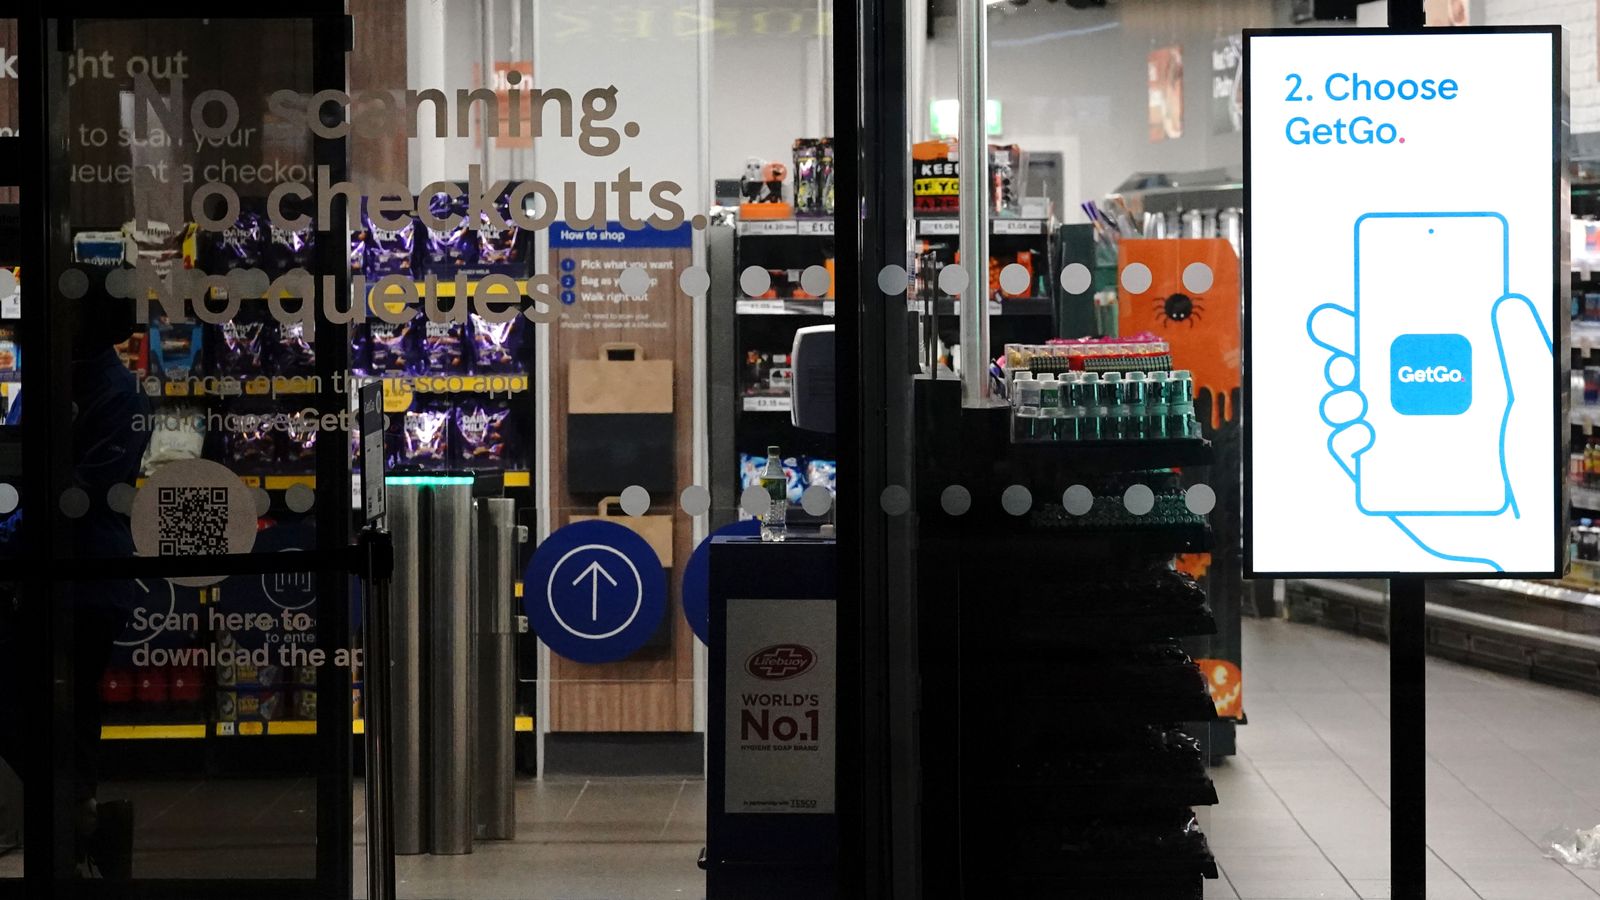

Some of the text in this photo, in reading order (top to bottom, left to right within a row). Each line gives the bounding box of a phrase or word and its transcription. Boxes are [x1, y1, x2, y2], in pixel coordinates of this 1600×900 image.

[126, 50, 188, 79] out
[1285, 72, 1459, 102] 2. Choose
[134, 70, 641, 157] No scanning.
[79, 124, 108, 147] to
[1285, 116, 1406, 145] GetGo.
[921, 163, 959, 176] KEE
[134, 163, 708, 232] No checkouts.
[560, 230, 625, 243] How to shop
[581, 260, 600, 269] Pick
[604, 260, 627, 269] what
[629, 261, 647, 269] you
[650, 261, 673, 269] want
[135, 262, 242, 325] No
[581, 276, 599, 287] Bag
[581, 292, 603, 301] Walk
[607, 291, 630, 303] right
[631, 293, 648, 301] out
[252, 375, 322, 400] open
[472, 375, 525, 400] app
[131, 407, 180, 432] and
[192, 408, 290, 432] choose
[132, 607, 199, 631] Scan
[208, 606, 274, 631] here
[280, 608, 311, 631] to
[265, 632, 316, 643] to ente
[132, 642, 269, 667] download
[278, 642, 326, 667] the
[754, 655, 808, 668] Lifebuoy
[741, 694, 819, 706] WORLD'S
[741, 709, 819, 741] No.1
